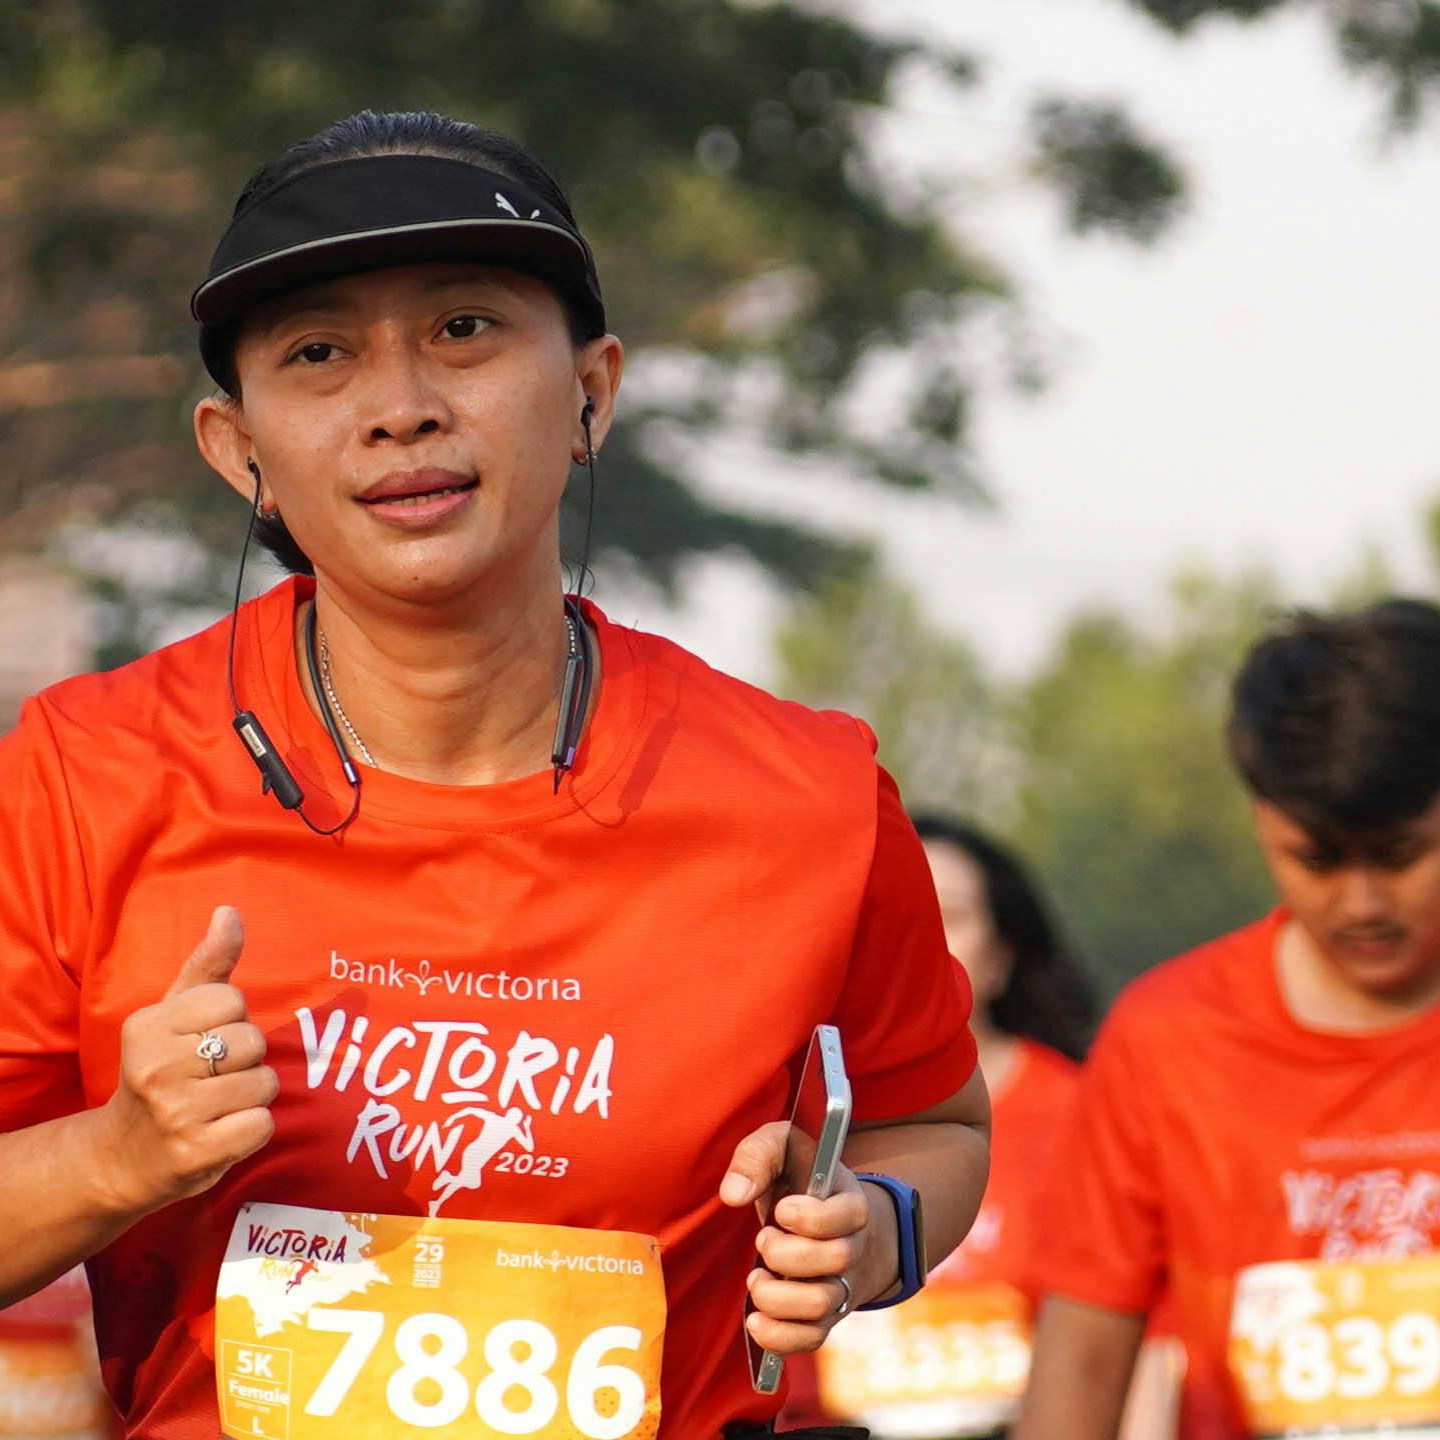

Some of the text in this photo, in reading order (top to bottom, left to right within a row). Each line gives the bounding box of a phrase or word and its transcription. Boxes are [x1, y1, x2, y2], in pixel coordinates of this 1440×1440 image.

[329, 950, 581, 1001] bank victoria
[494, 1151, 570, 1178] 2023
[413, 1242, 445, 1264] 29
[496, 1248, 644, 1276] bank victoria
[236, 1348, 273, 1378] 5K
[304, 1308, 646, 1440] 7886
[228, 1379, 290, 1406] Female
[252, 1415, 265, 1435] L
